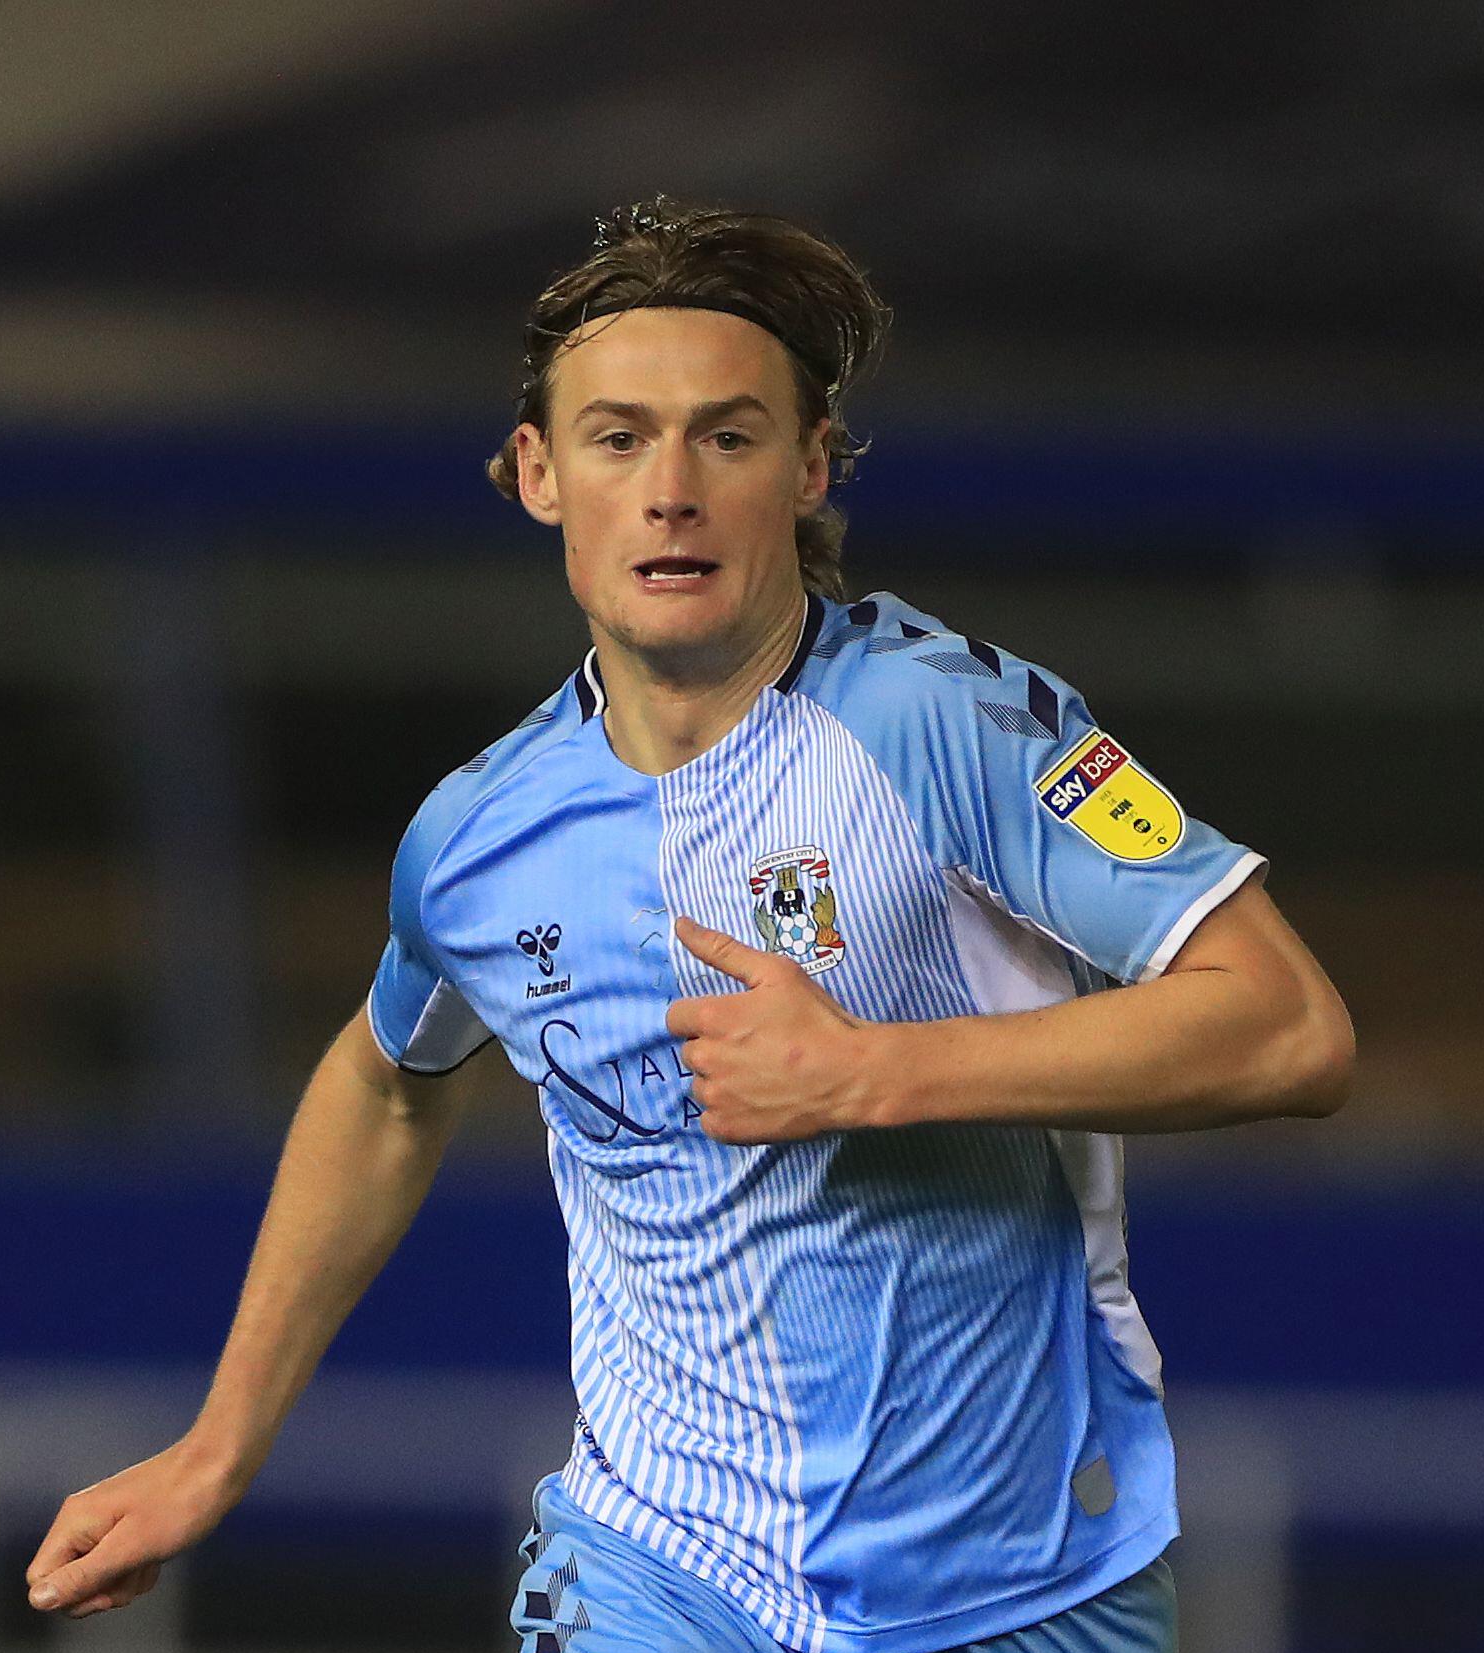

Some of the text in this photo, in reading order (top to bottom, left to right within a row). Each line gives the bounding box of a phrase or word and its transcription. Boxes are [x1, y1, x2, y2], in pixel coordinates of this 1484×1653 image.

[1050, 744, 1120, 812] sky bet
[526, 973, 572, 1000] hummel
[640, 1046, 695, 1086] AL
